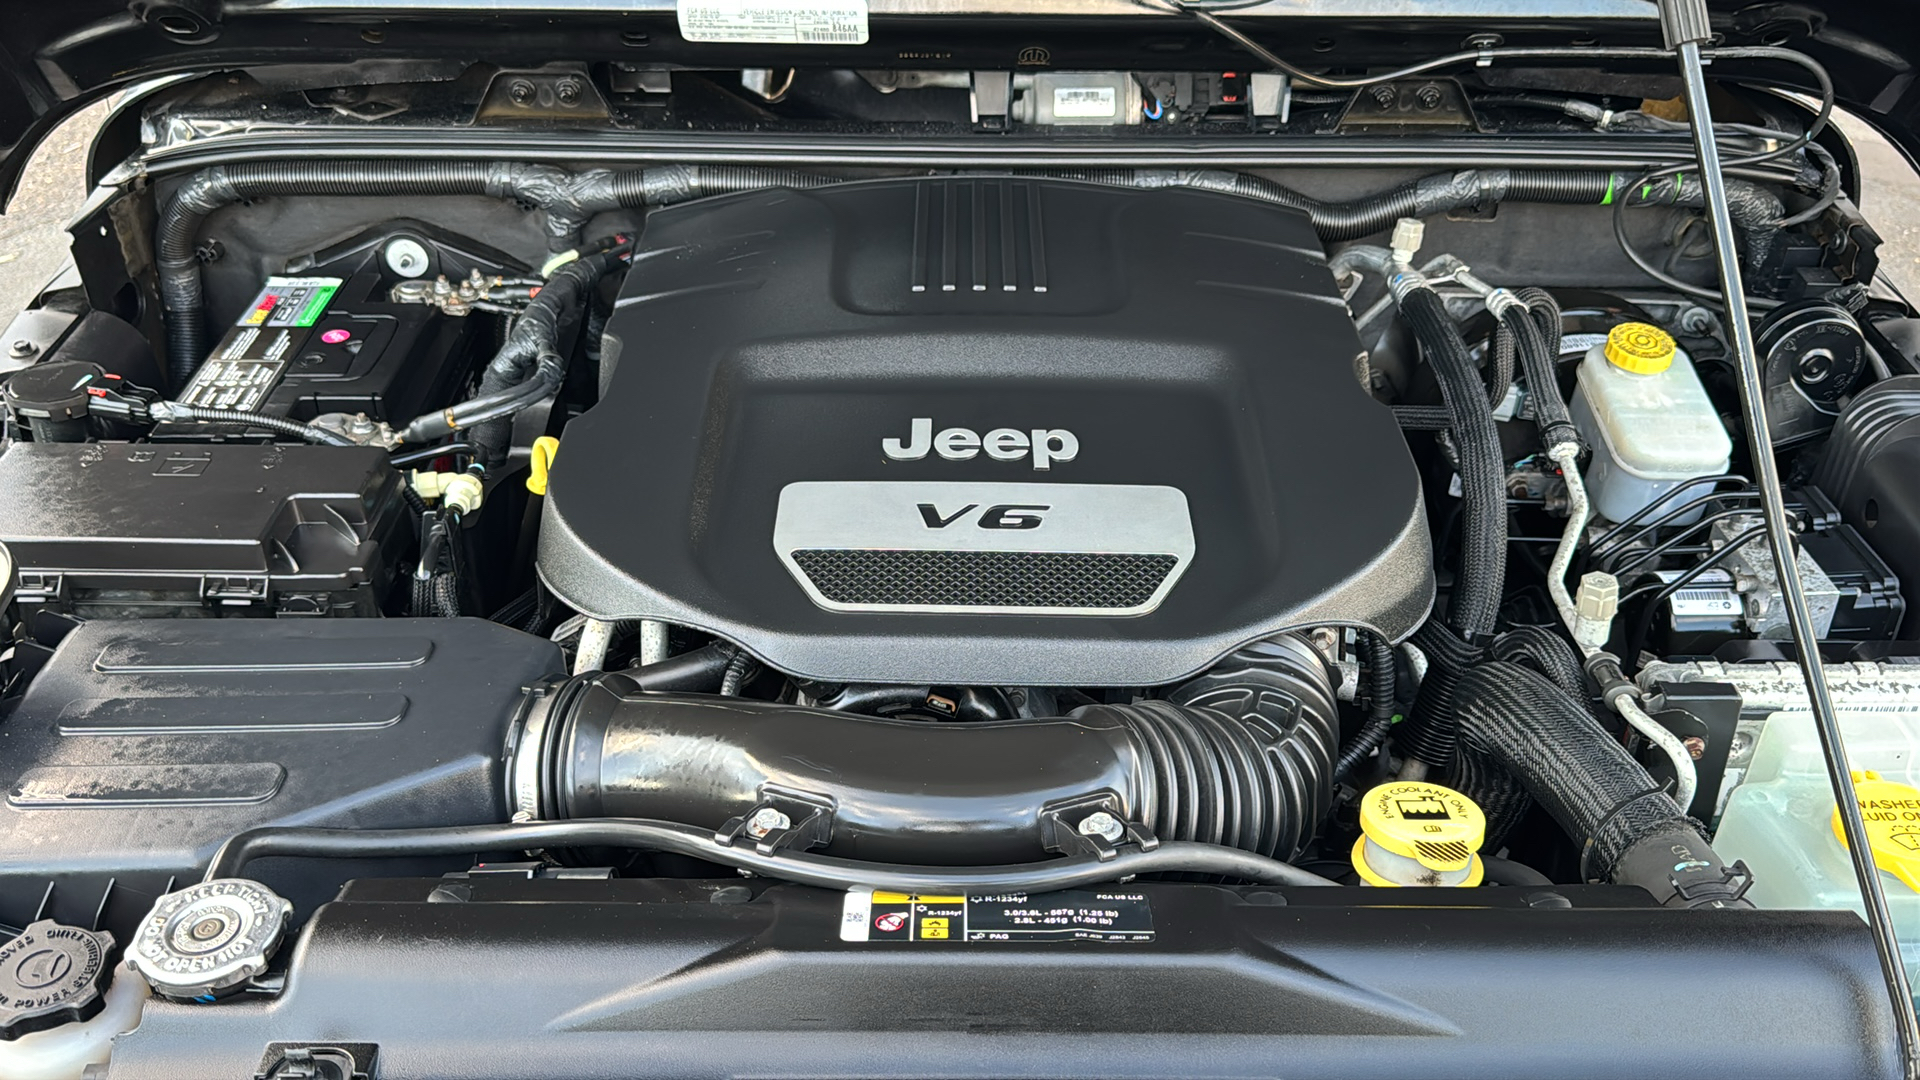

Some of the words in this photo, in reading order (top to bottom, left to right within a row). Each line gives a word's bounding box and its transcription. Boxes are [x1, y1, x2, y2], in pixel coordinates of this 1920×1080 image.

[882, 418, 1079, 471] Jeep
[916, 503, 1052, 530] V6
[1378, 793, 1394, 820] ENGINE
[1390, 786, 1450, 799] COOLANT
[1450, 799, 1469, 819] ONLY
[184, 884, 233, 902] KEEP
[984, 895, 1028, 904] R-1234yf
[163, 956, 216, 973] OPEN
